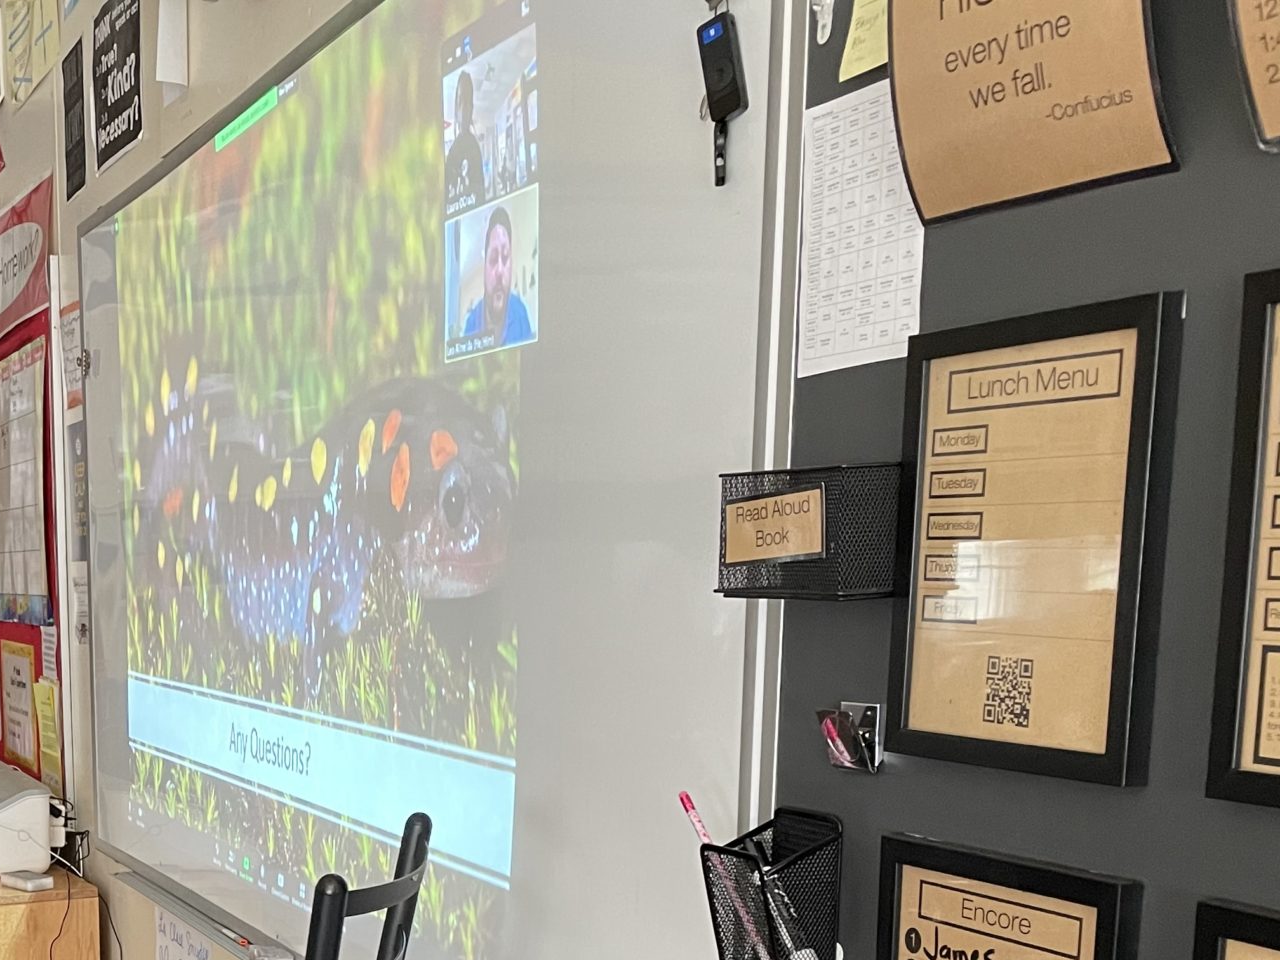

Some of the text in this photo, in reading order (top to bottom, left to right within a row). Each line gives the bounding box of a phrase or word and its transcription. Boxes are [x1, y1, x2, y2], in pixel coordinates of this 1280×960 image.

[944, 14, 1072, 73] every time
[1259, 32, 1280, 53] 1:
[107, 52, 136, 107] Kind?
[969, 61, 1053, 109] we fall.
[1045, 88, 1134, 121] -Confucius
[97, 94, 139, 153] Necessary?
[966, 363, 1099, 401] Lunch Menu
[938, 431, 982, 450] Monday
[934, 475, 979, 492] Tuesday
[735, 494, 811, 525] Read Aloud
[930, 520, 979, 533] Wednesday
[754, 527, 790, 548] Book
[228, 722, 312, 777] Any Questions?
[961, 897, 1032, 935] Encore
